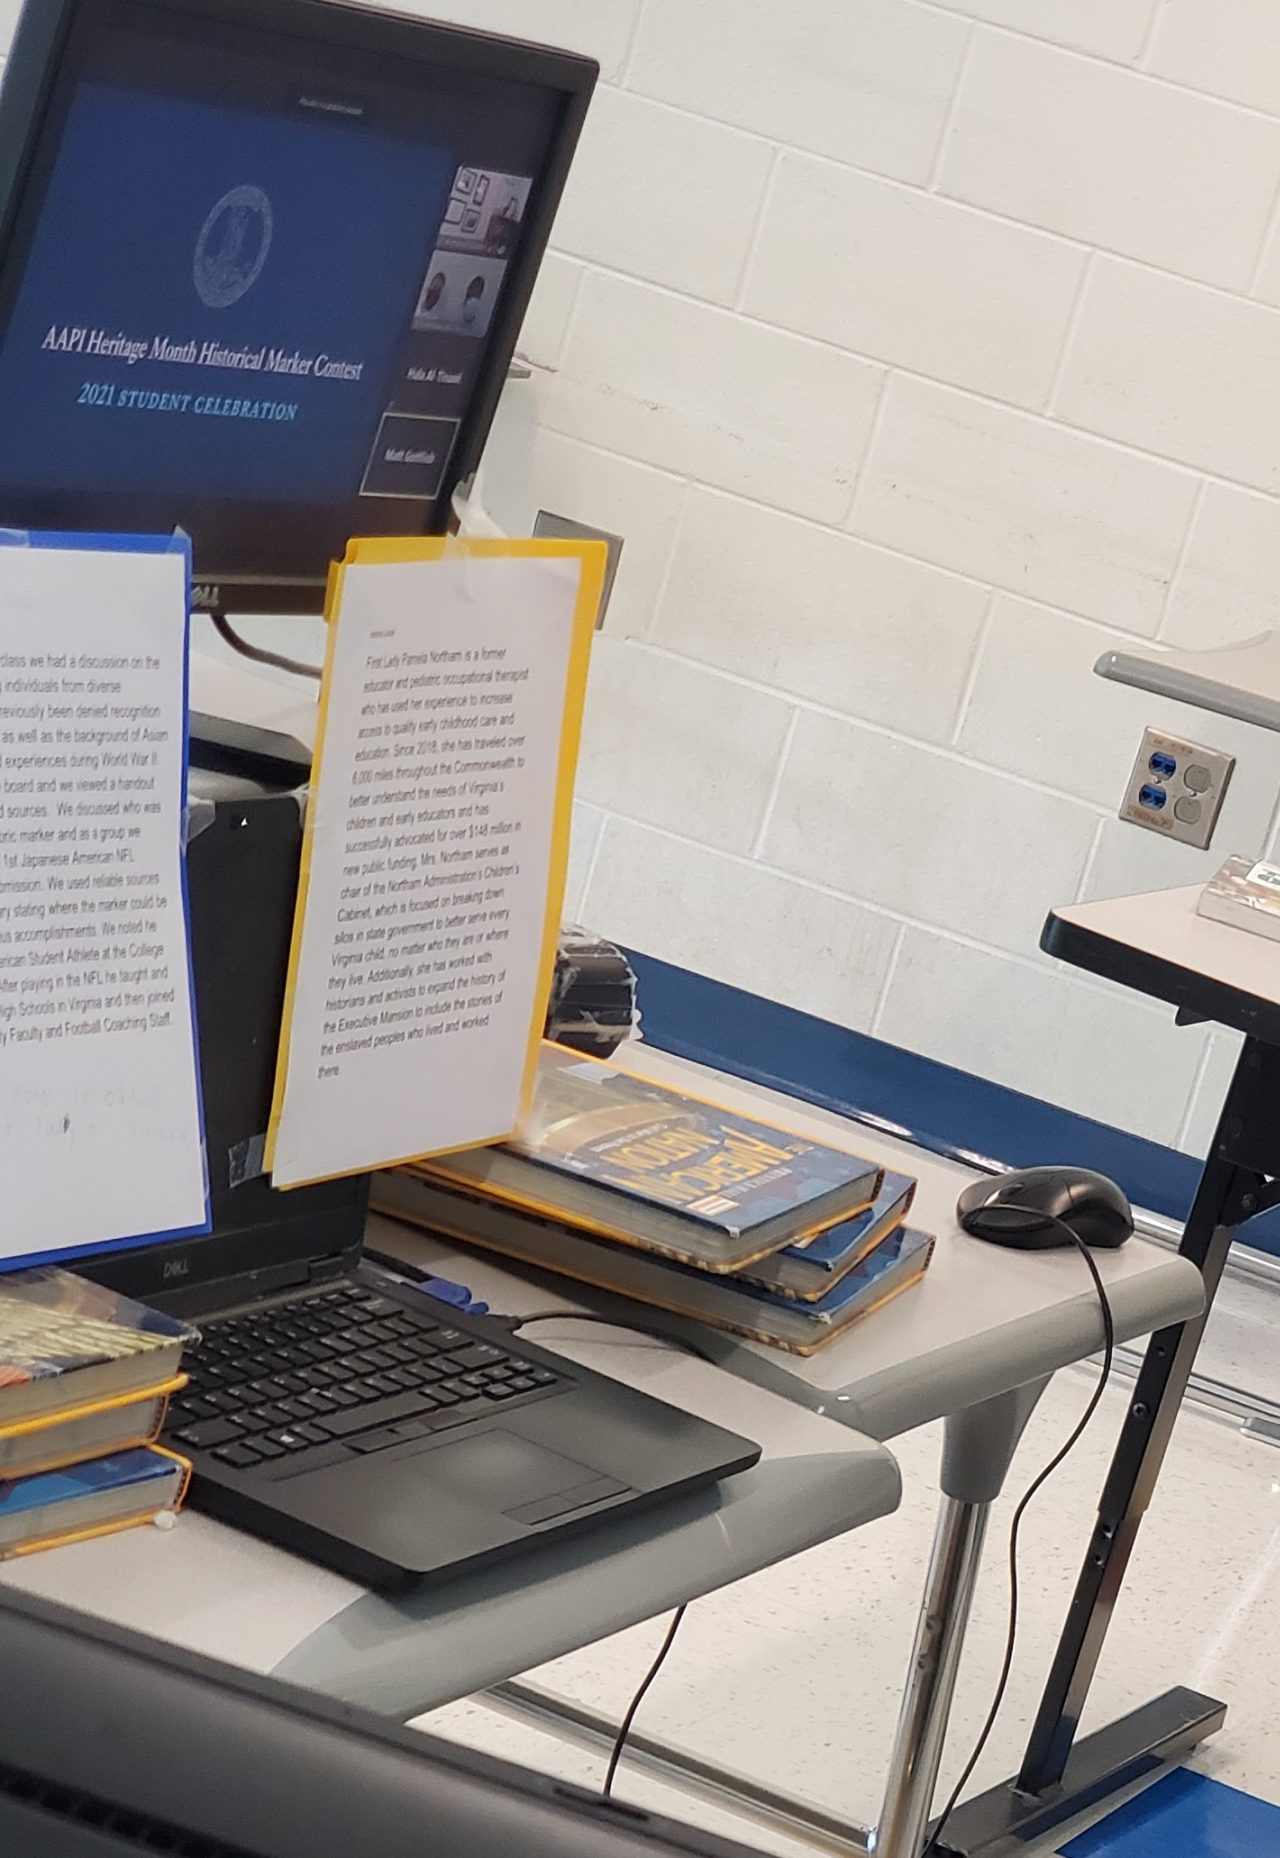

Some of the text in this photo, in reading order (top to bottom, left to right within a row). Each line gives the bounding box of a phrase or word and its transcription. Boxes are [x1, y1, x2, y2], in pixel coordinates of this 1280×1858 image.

[42, 325, 363, 380] AAPI Heritage Month Historical Marker Contest
[78, 382, 298, 421] 2021 STUDENT CELEBRATION
[600, 1126, 720, 1174] NATION
[601, 1125, 795, 1205] AMERICAN
